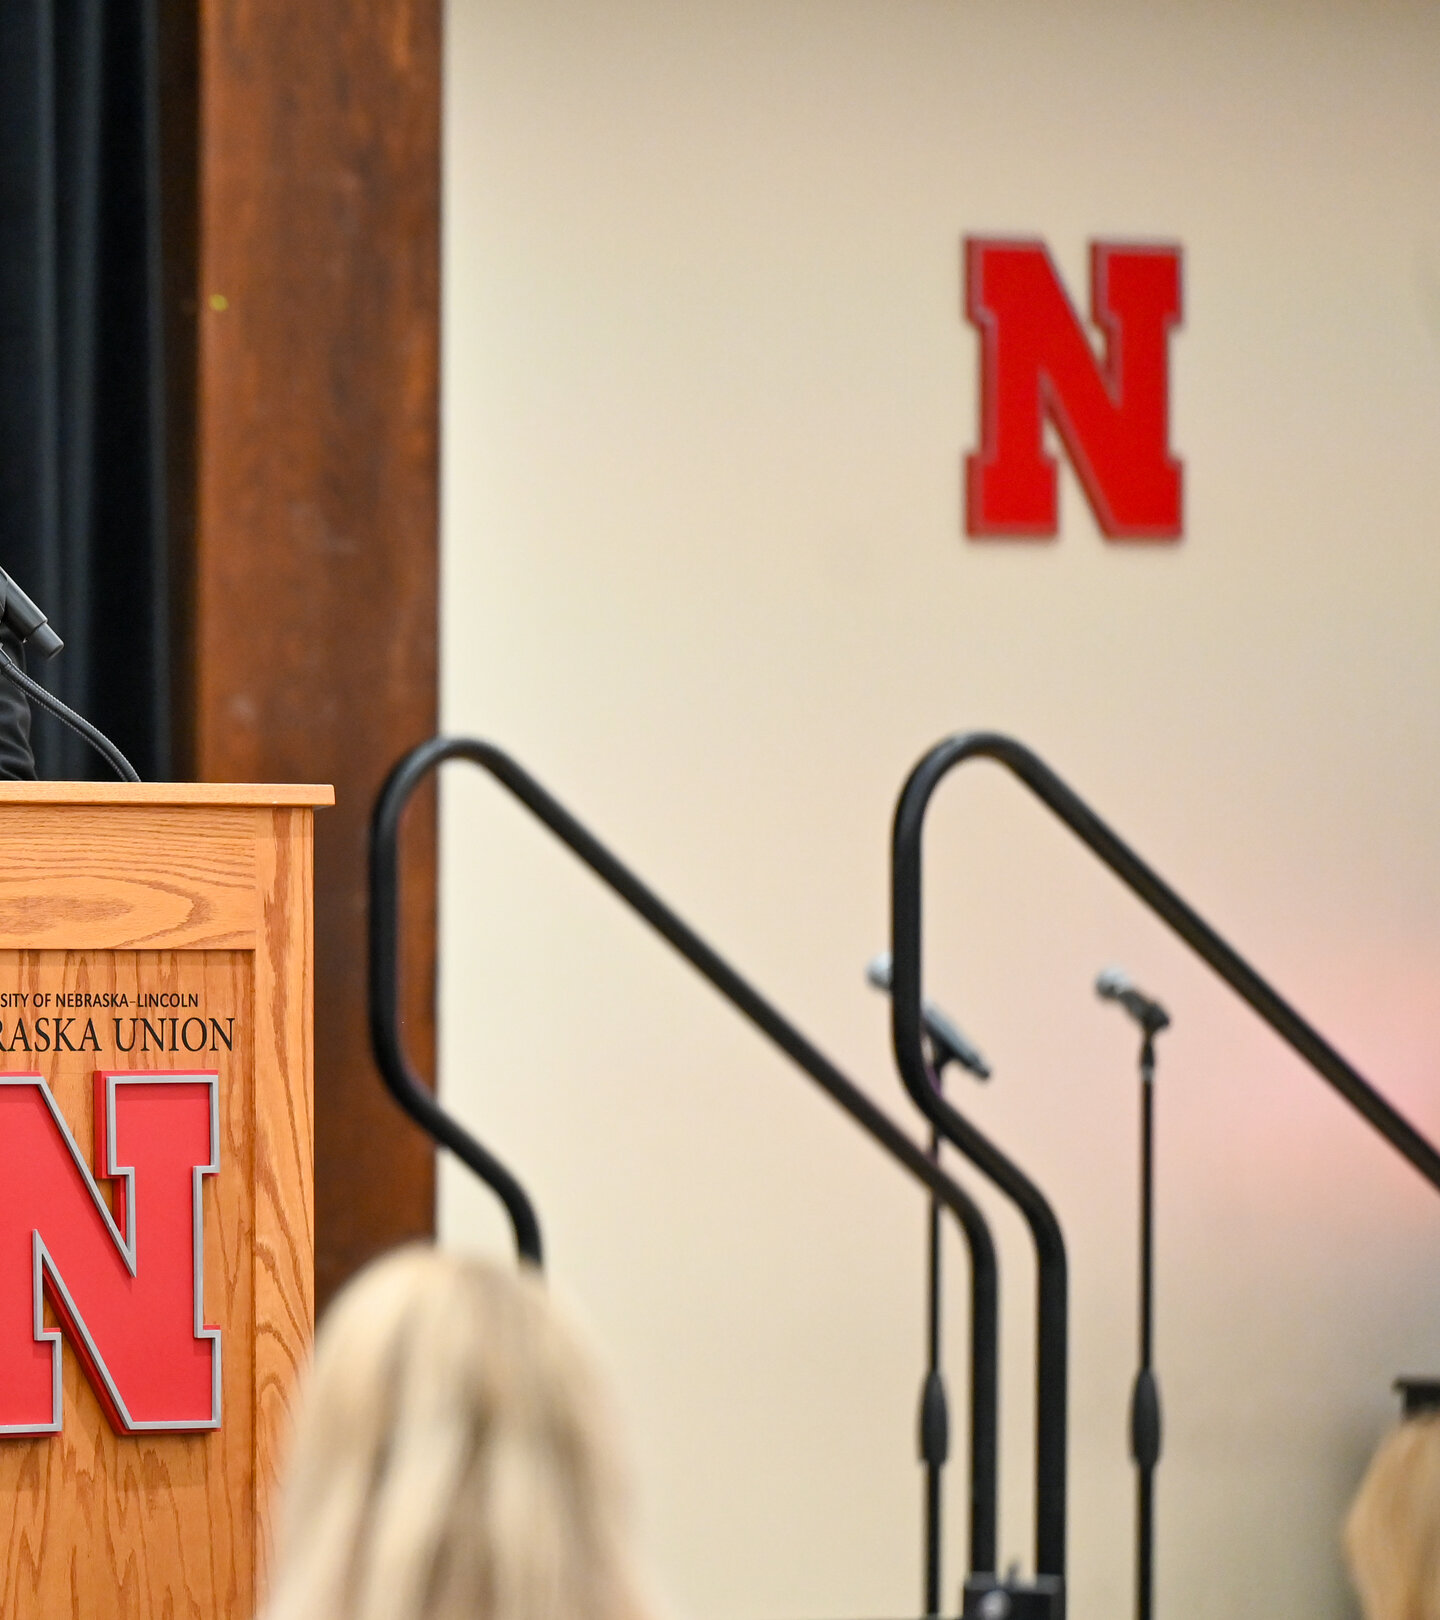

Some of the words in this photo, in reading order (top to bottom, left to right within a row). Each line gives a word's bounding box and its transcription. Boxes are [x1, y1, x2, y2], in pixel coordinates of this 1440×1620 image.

[963, 237, 1185, 542] N
[32, 993, 51, 1008] OF
[112, 1017, 235, 1052] UNION
